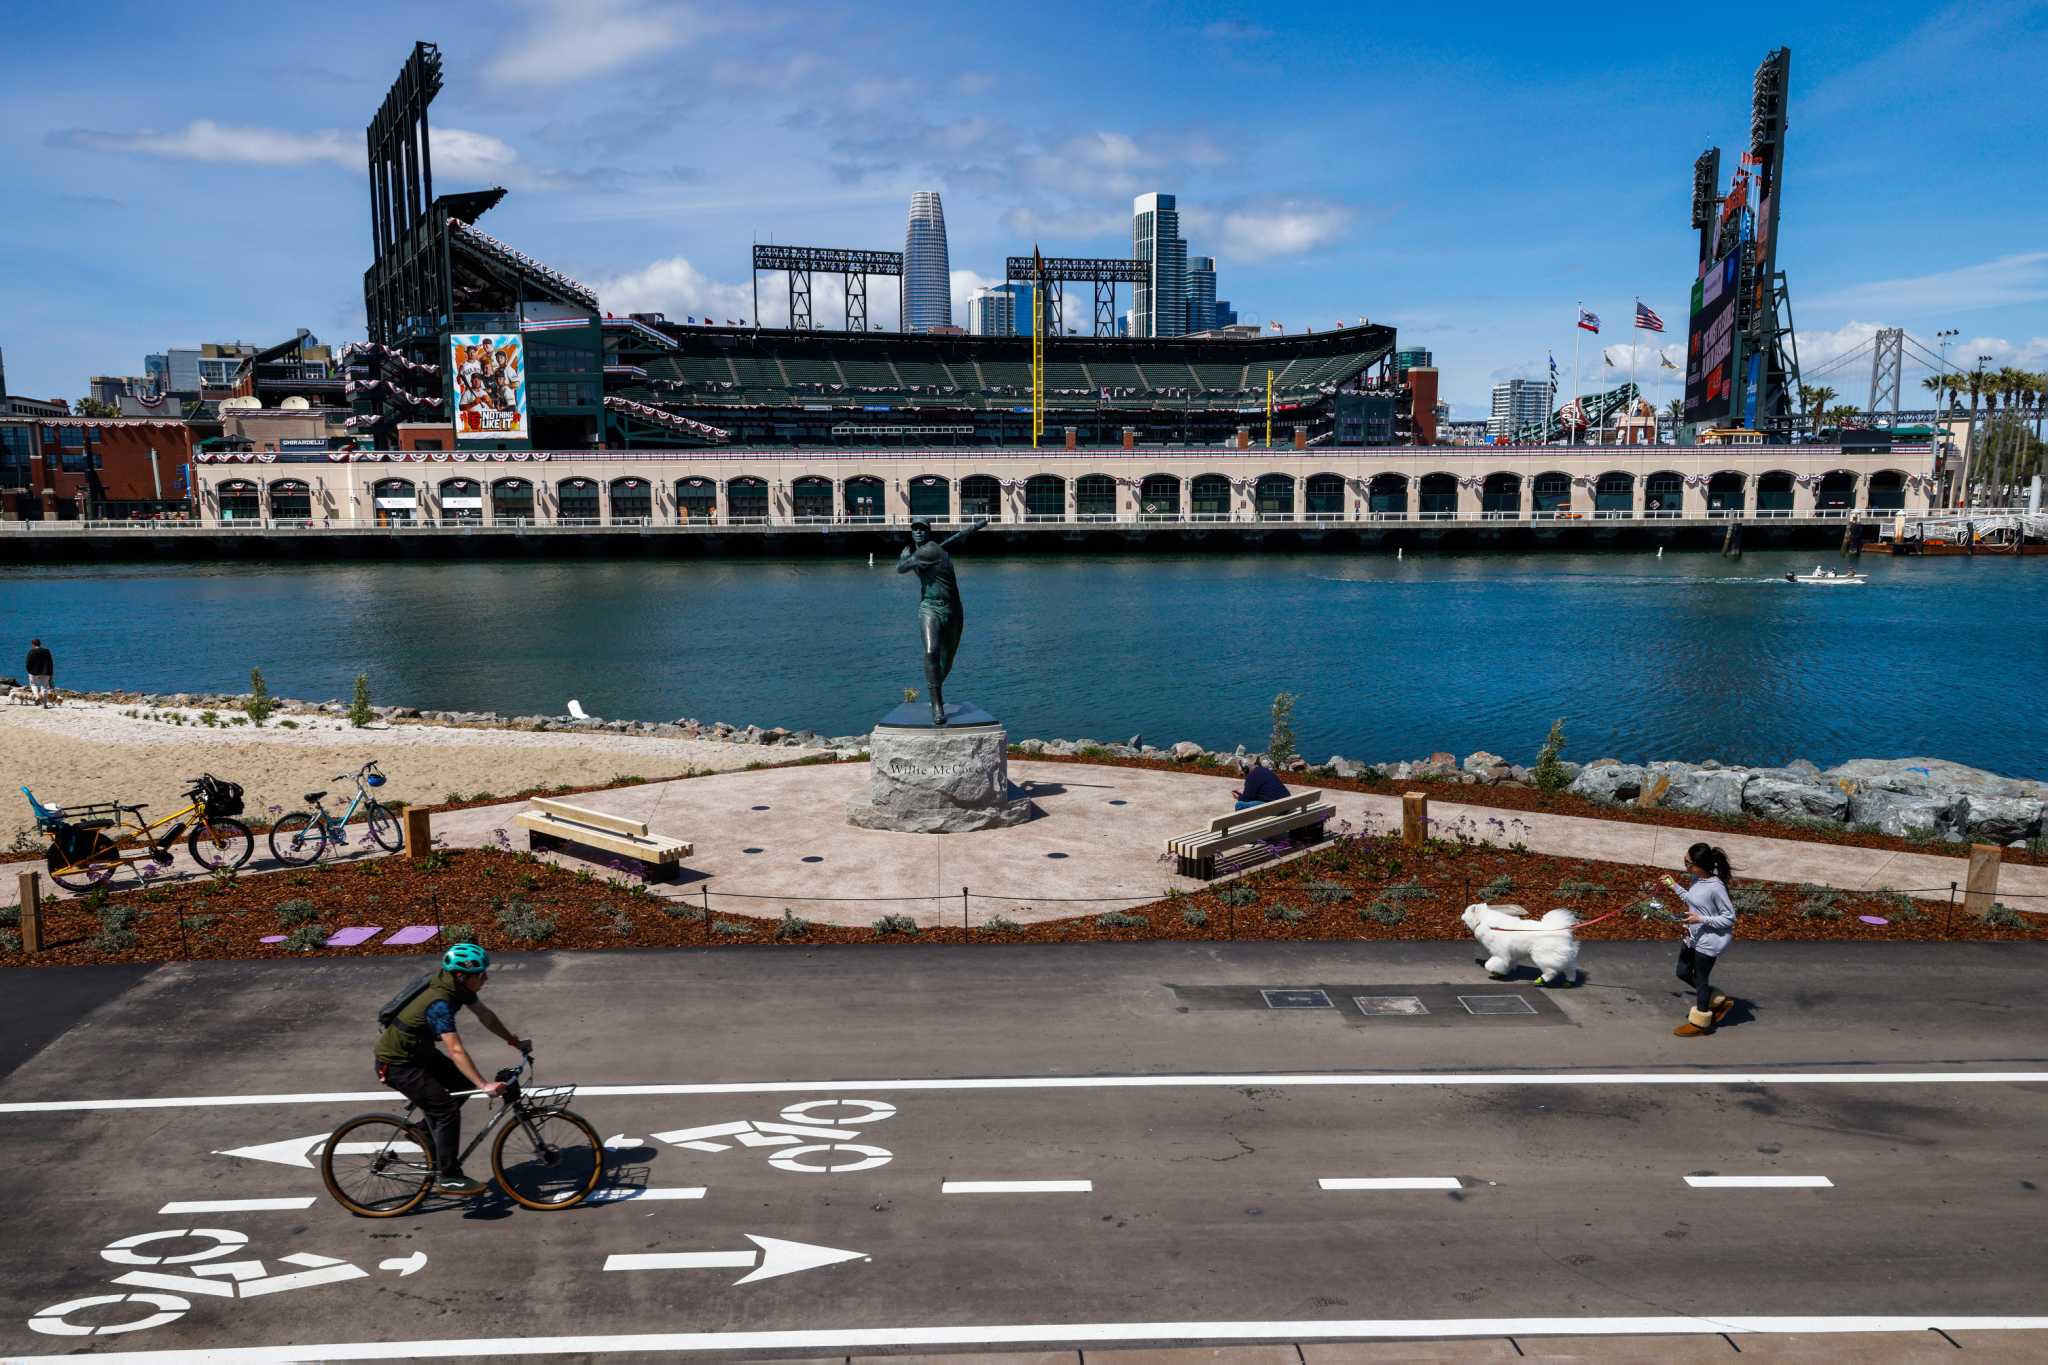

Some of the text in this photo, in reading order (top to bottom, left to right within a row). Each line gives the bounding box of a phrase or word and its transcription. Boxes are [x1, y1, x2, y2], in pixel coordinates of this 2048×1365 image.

[482, 411, 513, 420] NOTHING
[482, 419, 512, 429] LIKE IT
[890, 764, 986, 777] Willie McCove
